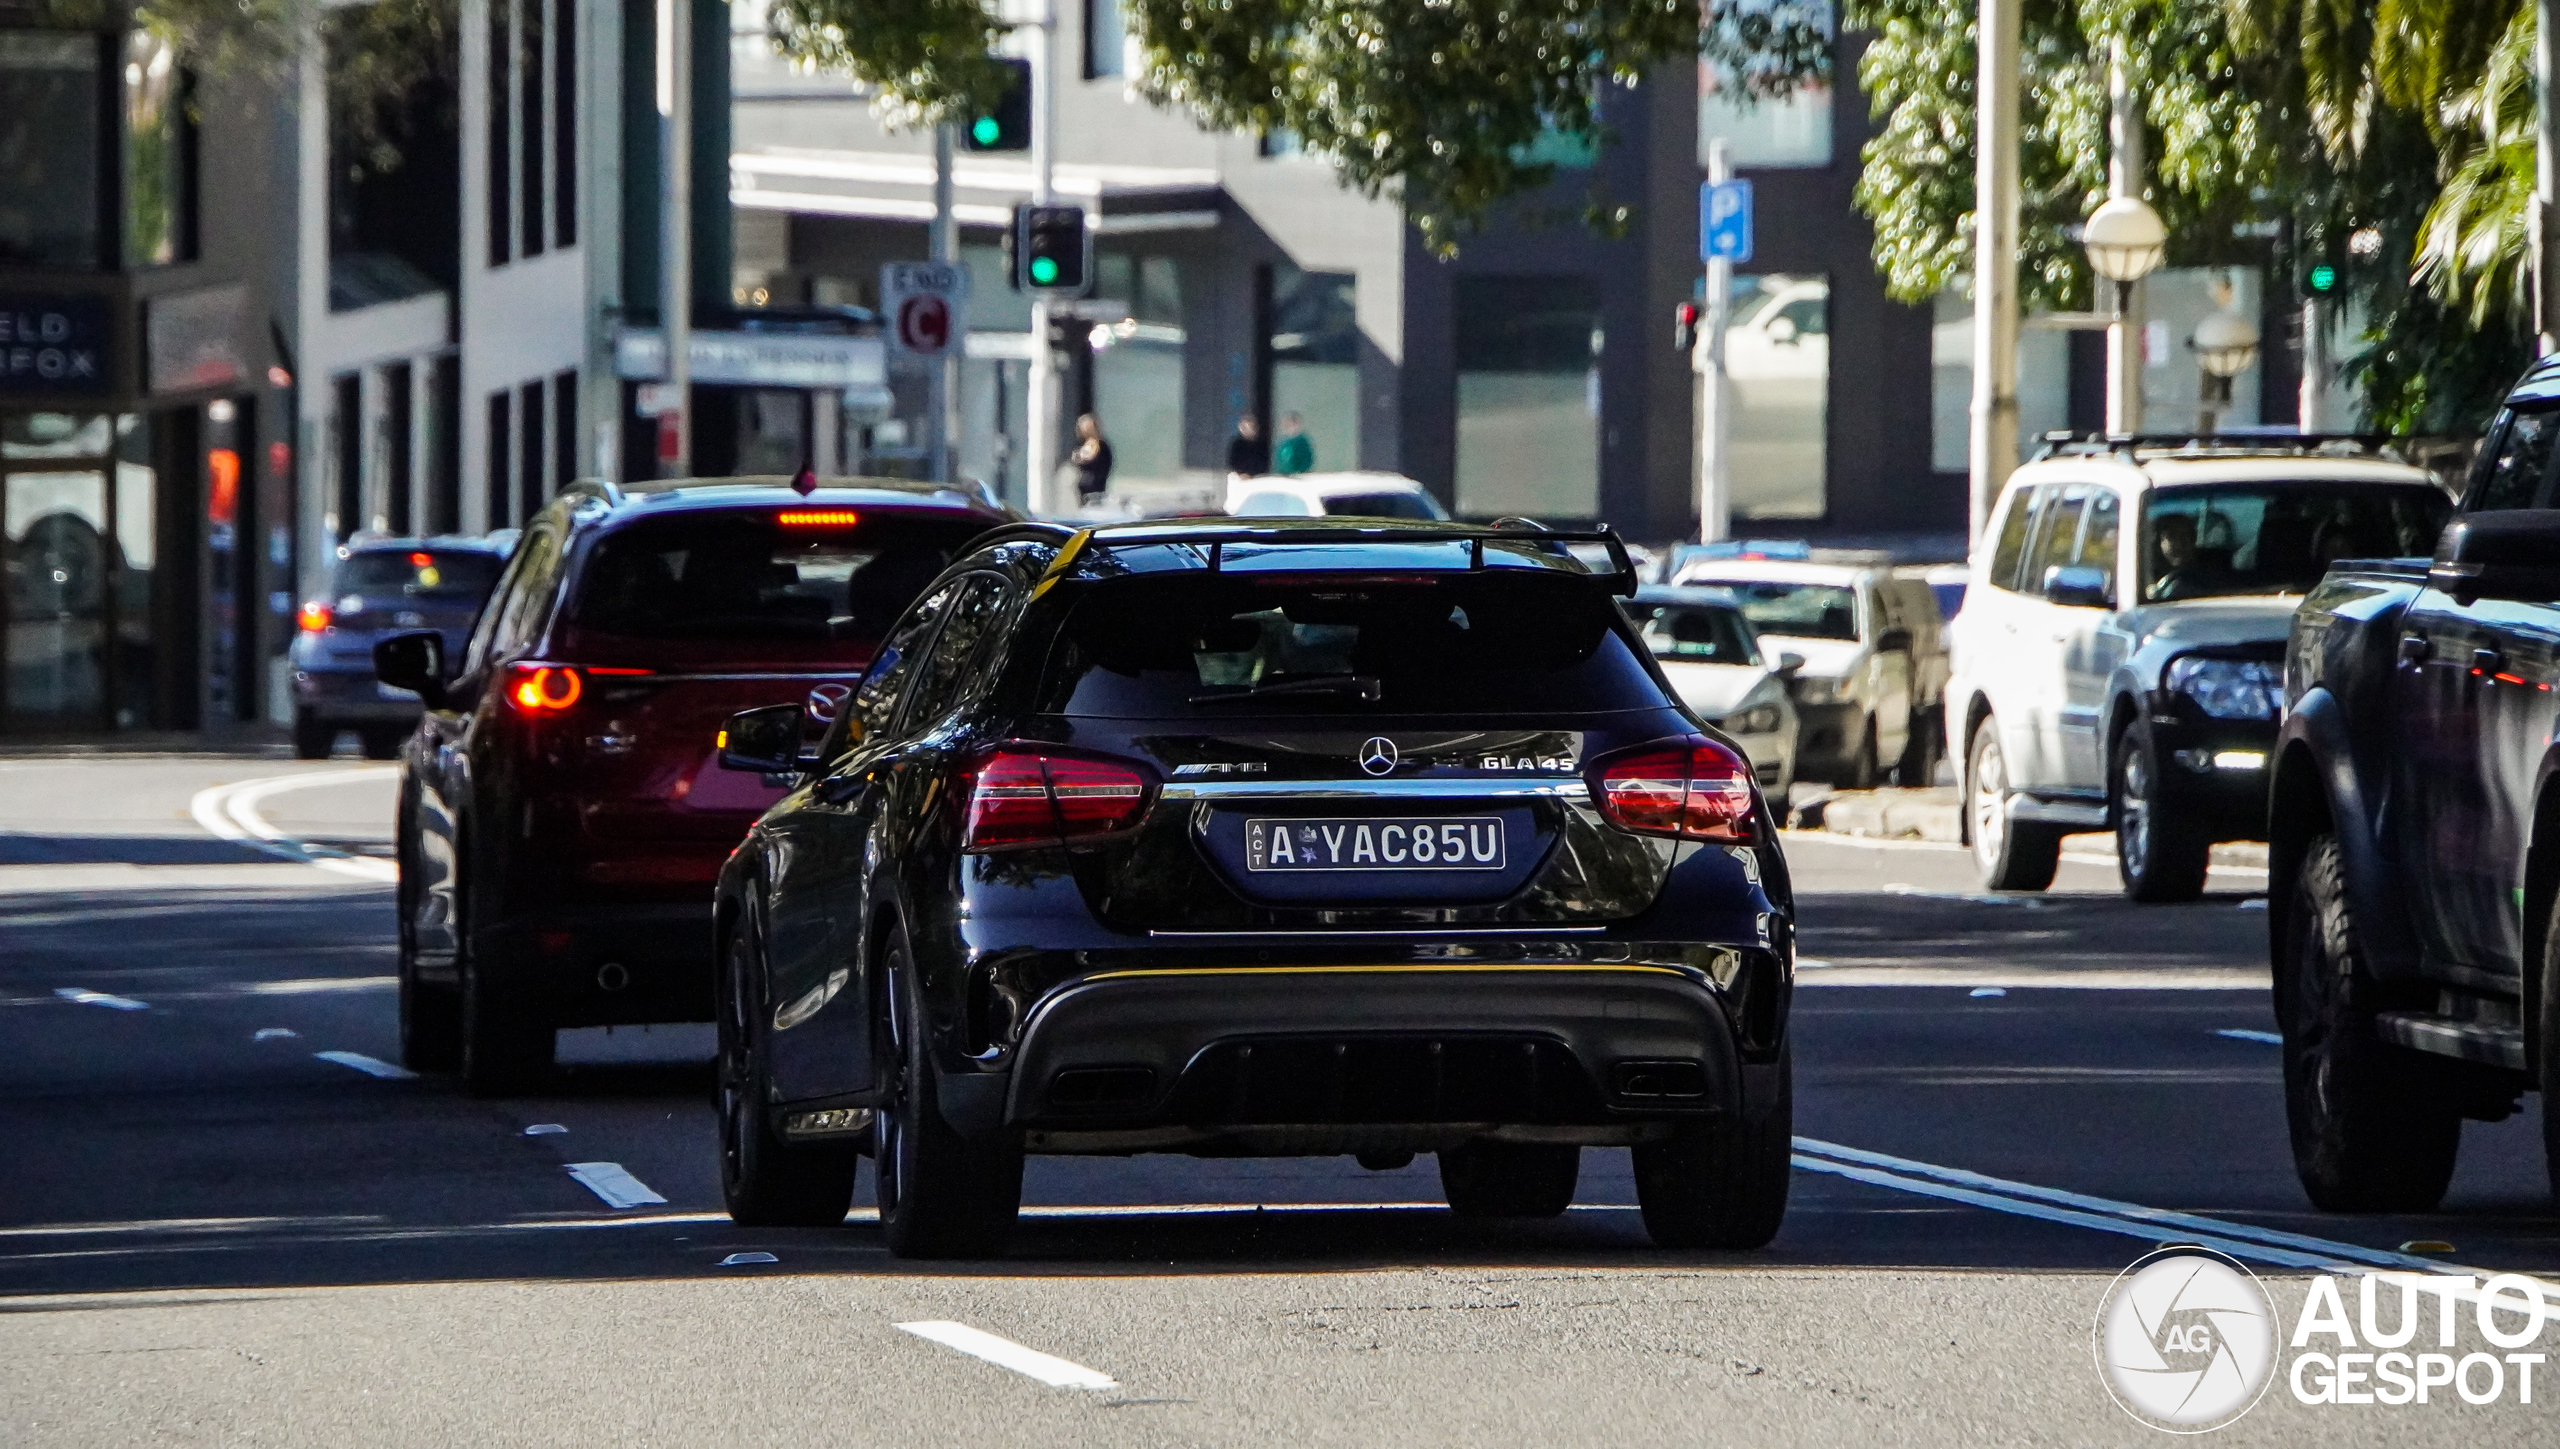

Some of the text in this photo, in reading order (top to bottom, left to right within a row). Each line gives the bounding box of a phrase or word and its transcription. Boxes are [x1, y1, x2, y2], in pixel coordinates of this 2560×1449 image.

[1711, 187, 1741, 226] P
[1203, 762, 1267, 772] AMG
[1483, 756, 1575, 771] GLA 45
[1321, 824, 1497, 863] YAC85U
